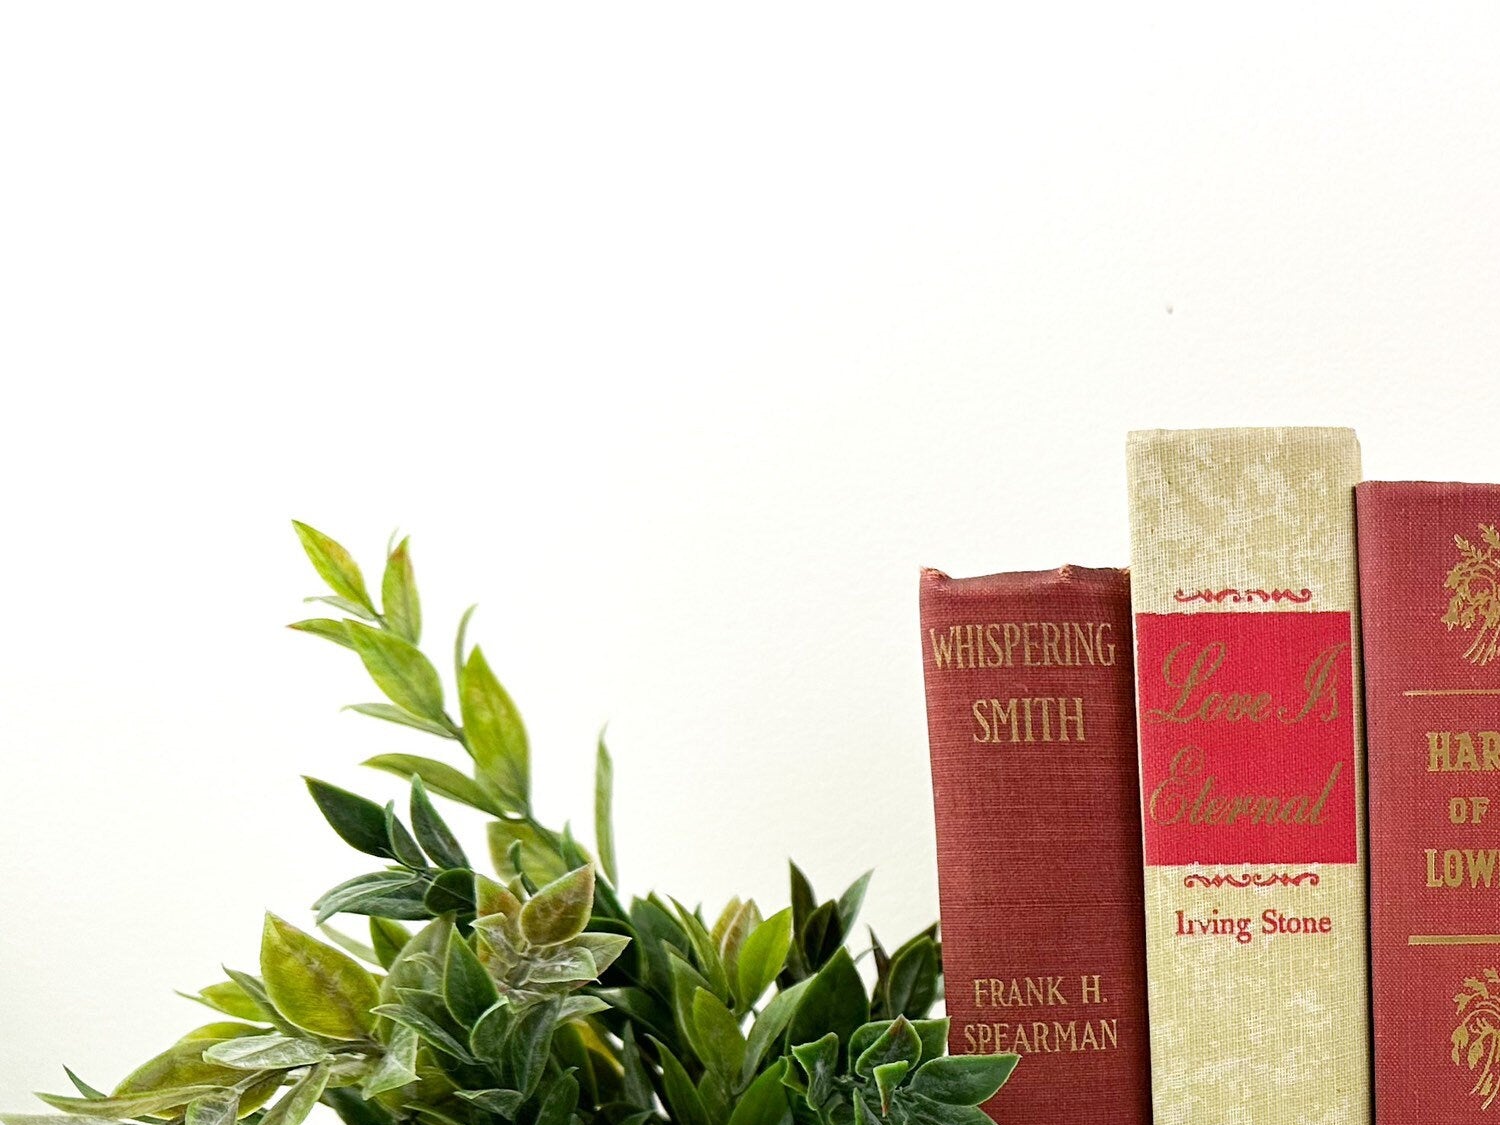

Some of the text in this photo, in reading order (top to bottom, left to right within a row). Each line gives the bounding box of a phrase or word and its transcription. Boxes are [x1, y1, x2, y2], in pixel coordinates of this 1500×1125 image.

[929, 622, 1117, 671] WHISPERING
[1145, 640, 1350, 725] Love Is
[972, 697, 1086, 743] SMITH
[1148, 744, 1343, 828] Eternal
[1449, 797, 1490, 825] OF
[1174, 909, 1332, 945] Irving Stone
[973, 975, 1108, 1008] FRANK H.
[963, 1018, 1118, 1054] SPEARMAN
